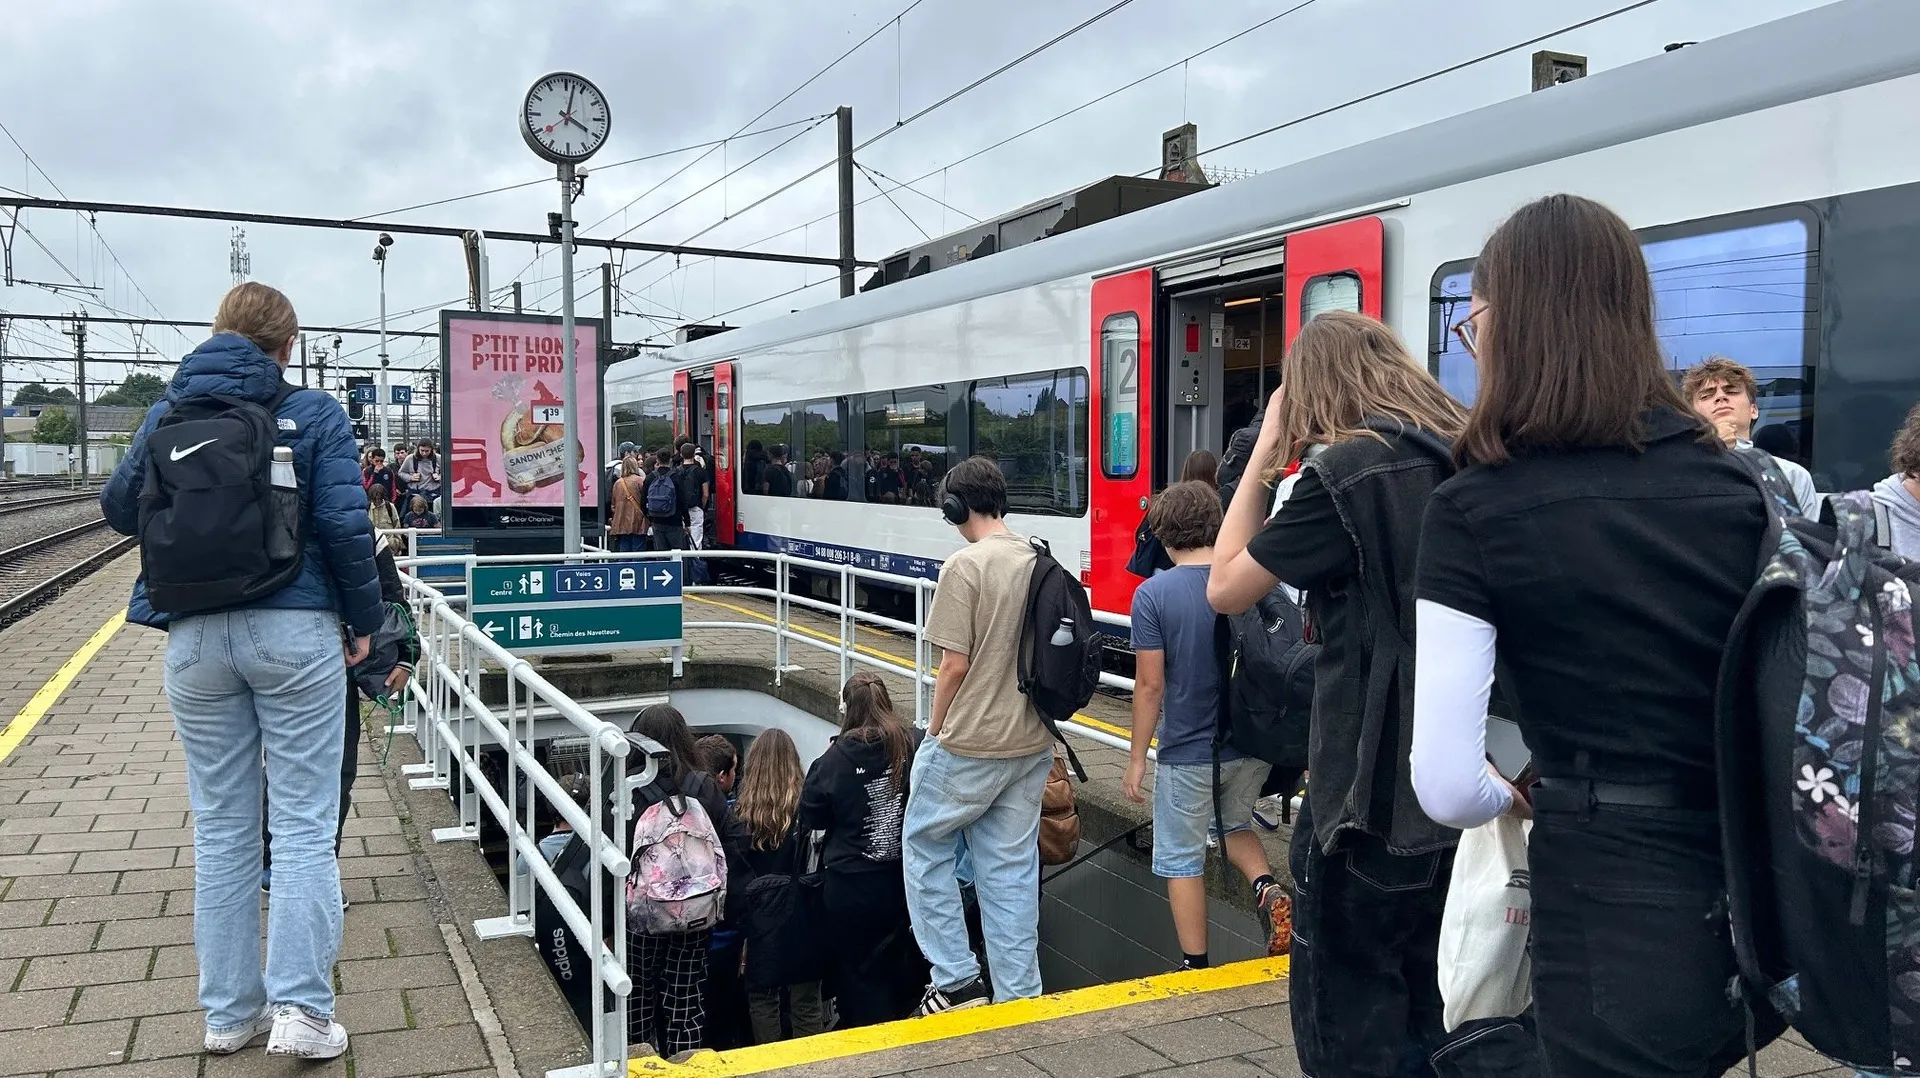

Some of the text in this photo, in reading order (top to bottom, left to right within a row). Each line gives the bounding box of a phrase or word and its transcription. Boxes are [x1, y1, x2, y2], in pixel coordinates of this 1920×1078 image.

[472, 334, 519, 353] P'TIT
[472, 353, 519, 372] P'TIT
[1119, 348, 1137, 395] 2
[364, 391, 370, 399] 5
[564, 577, 571, 590] 1
[593, 576, 603, 589] 3
[552, 927, 573, 980] adidas
